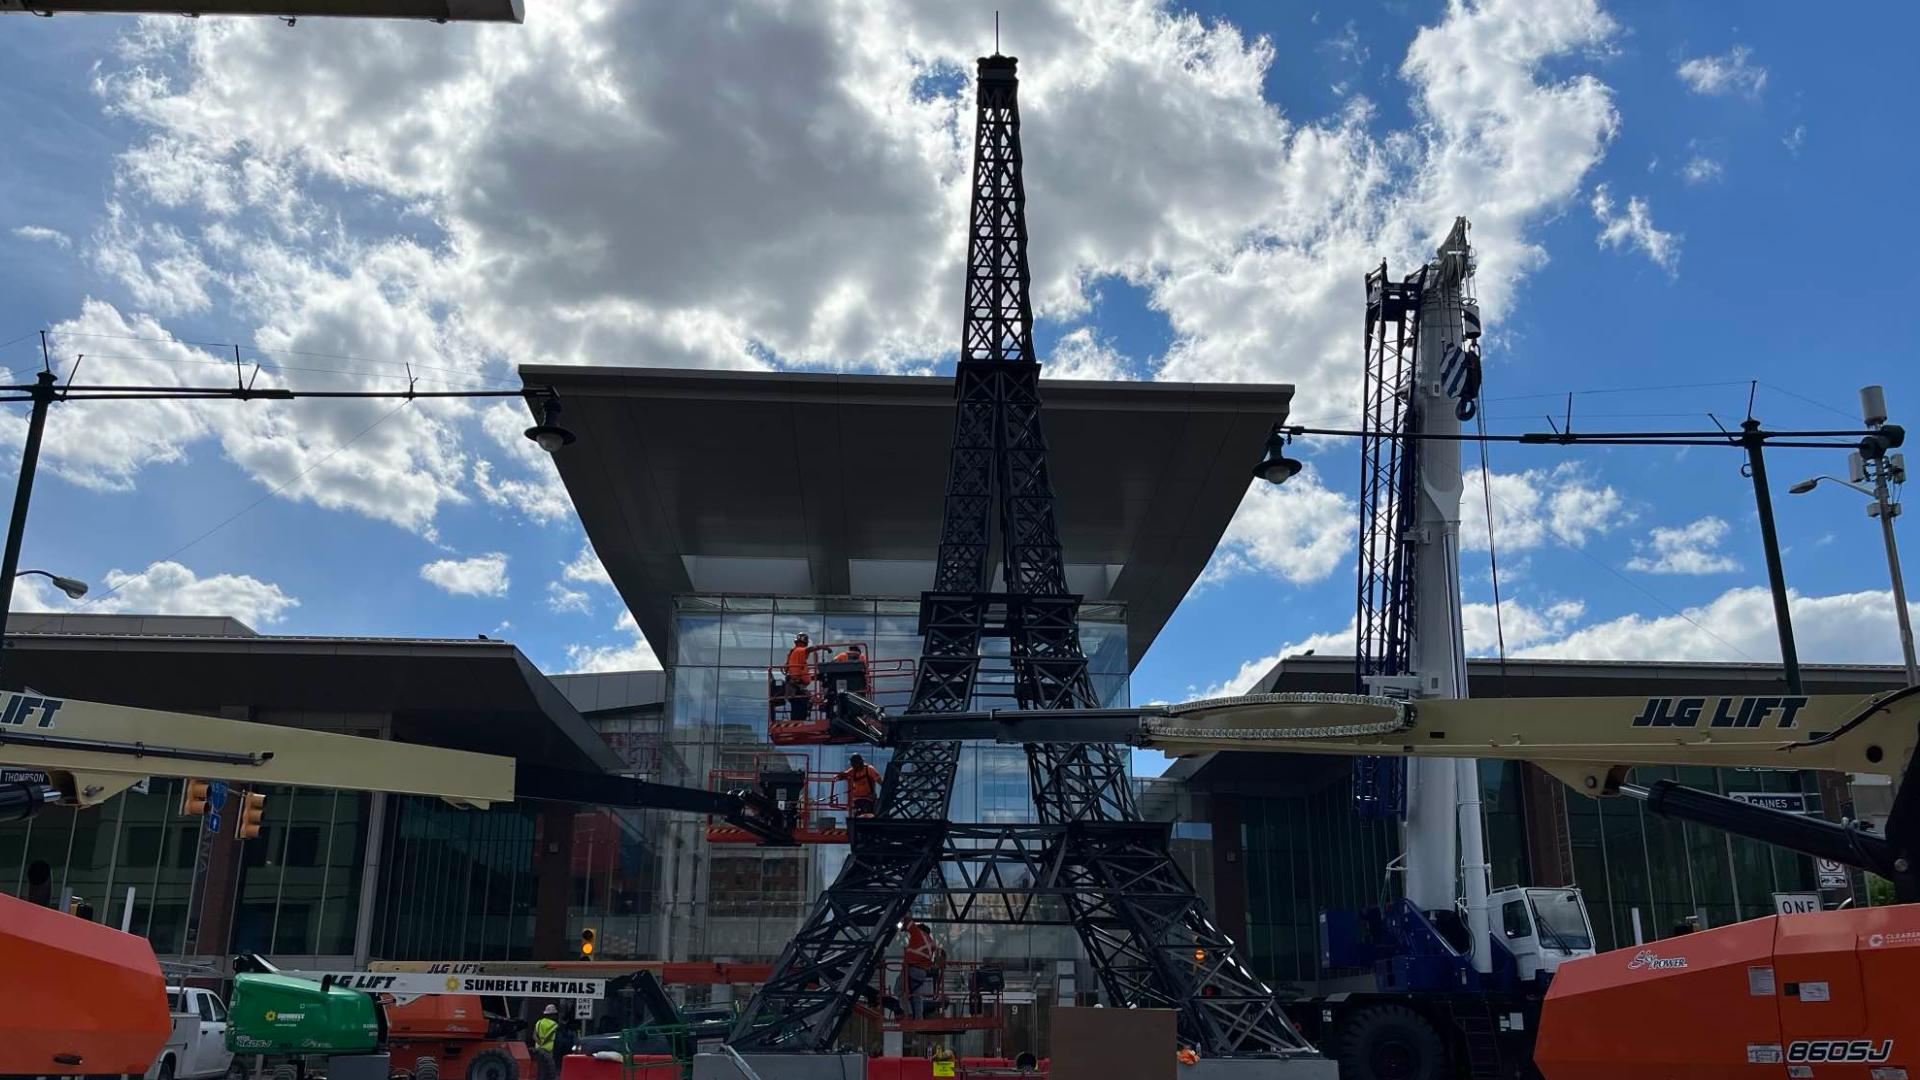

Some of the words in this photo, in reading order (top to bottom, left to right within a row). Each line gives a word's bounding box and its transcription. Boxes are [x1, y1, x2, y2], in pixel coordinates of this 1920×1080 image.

[0, 693, 63, 728] IFT
[1632, 697, 1706, 728] JLG
[1709, 696, 1808, 729] LIFT
[1751, 799, 1788, 809] GAINES
[427, 963, 450, 974] JLG
[355, 975, 397, 989] LIFT
[464, 979, 528, 992] SUNBELT
[531, 981, 595, 994] RENTALS
[1011, 1005, 1019, 1015] 9
[1787, 1039, 1894, 1063] 860SJ
